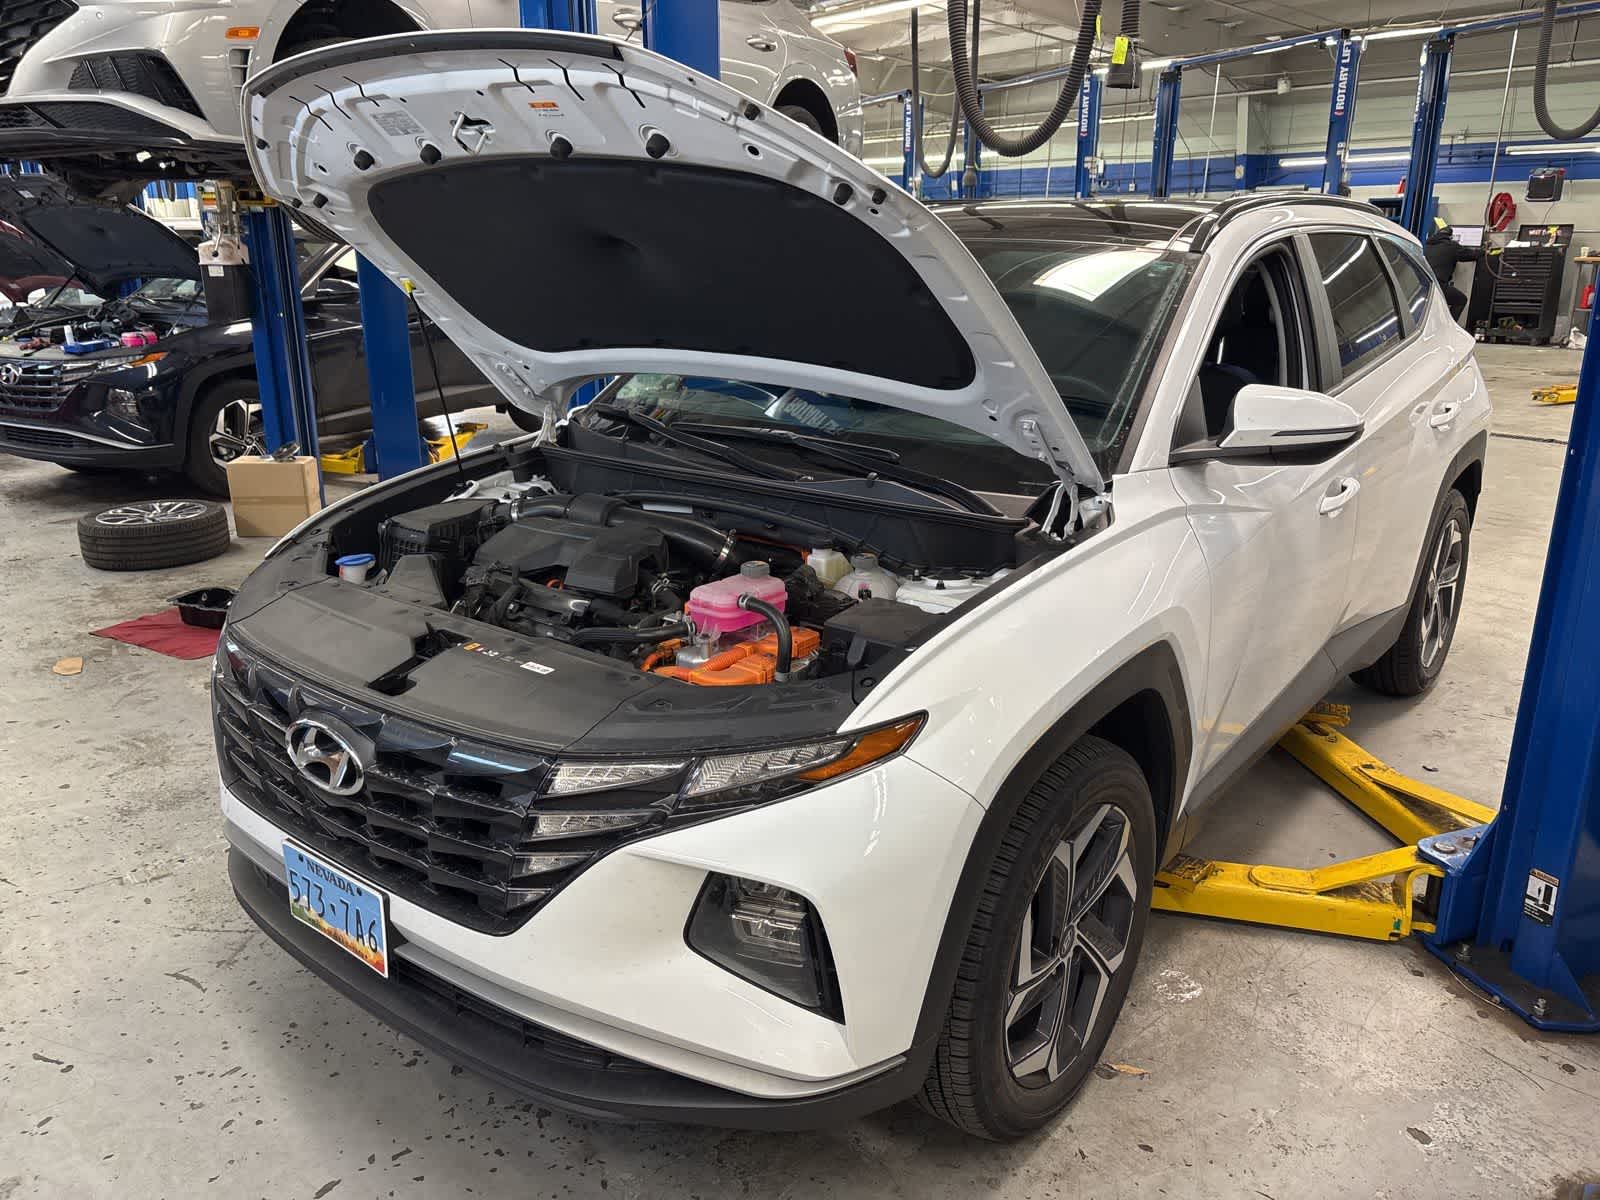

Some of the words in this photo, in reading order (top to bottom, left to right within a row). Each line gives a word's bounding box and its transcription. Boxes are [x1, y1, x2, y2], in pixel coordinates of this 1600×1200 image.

[1341, 39, 1352, 64] LIFT
[1083, 74, 1091, 93] LIFT
[1335, 66, 1350, 110] ROTARY
[1080, 95, 1090, 132] ROTARY
[306, 859, 355, 896] NEVADA
